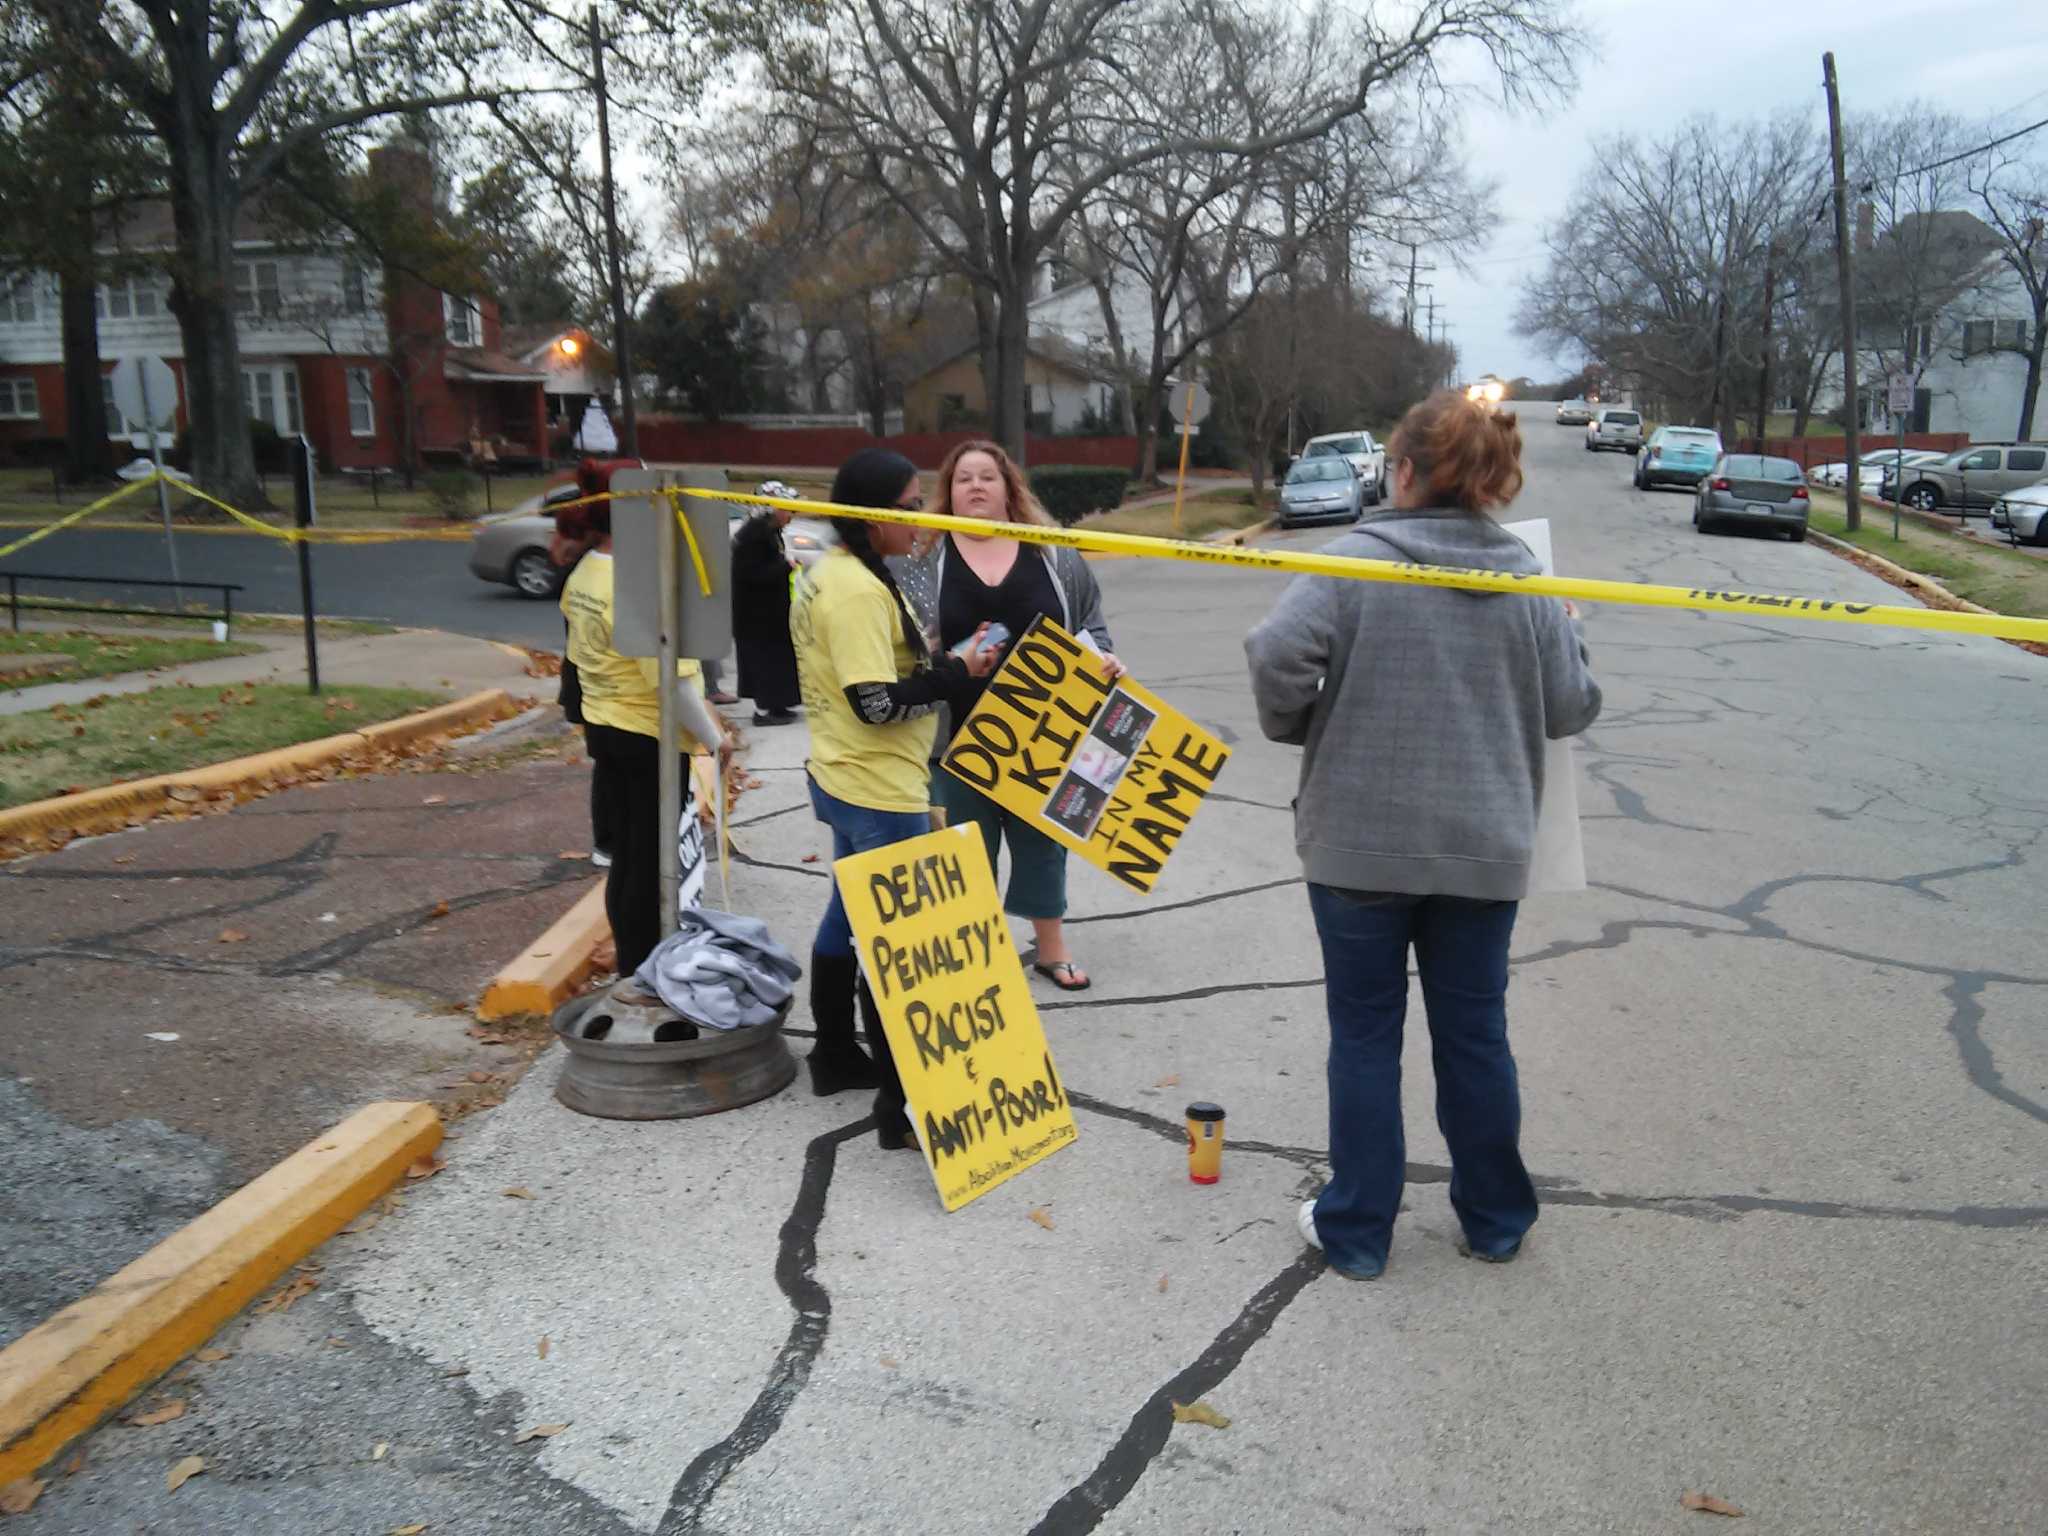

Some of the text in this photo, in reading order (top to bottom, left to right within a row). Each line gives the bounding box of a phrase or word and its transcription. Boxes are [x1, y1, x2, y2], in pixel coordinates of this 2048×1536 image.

[946, 713, 1018, 791] DO
[989, 616, 1085, 720] NOT
[1008, 666, 1120, 795] KILL
[1090, 796, 1132, 852] IN
[1125, 740, 1163, 787] MY
[1107, 733, 1229, 893] NAME
[870, 853, 967, 926] DEATH
[872, 913, 1006, 1000] PENALTY:
[905, 984, 1006, 1071] RACIST
[924, 1051, 1064, 1169] ANTI-POOR!
